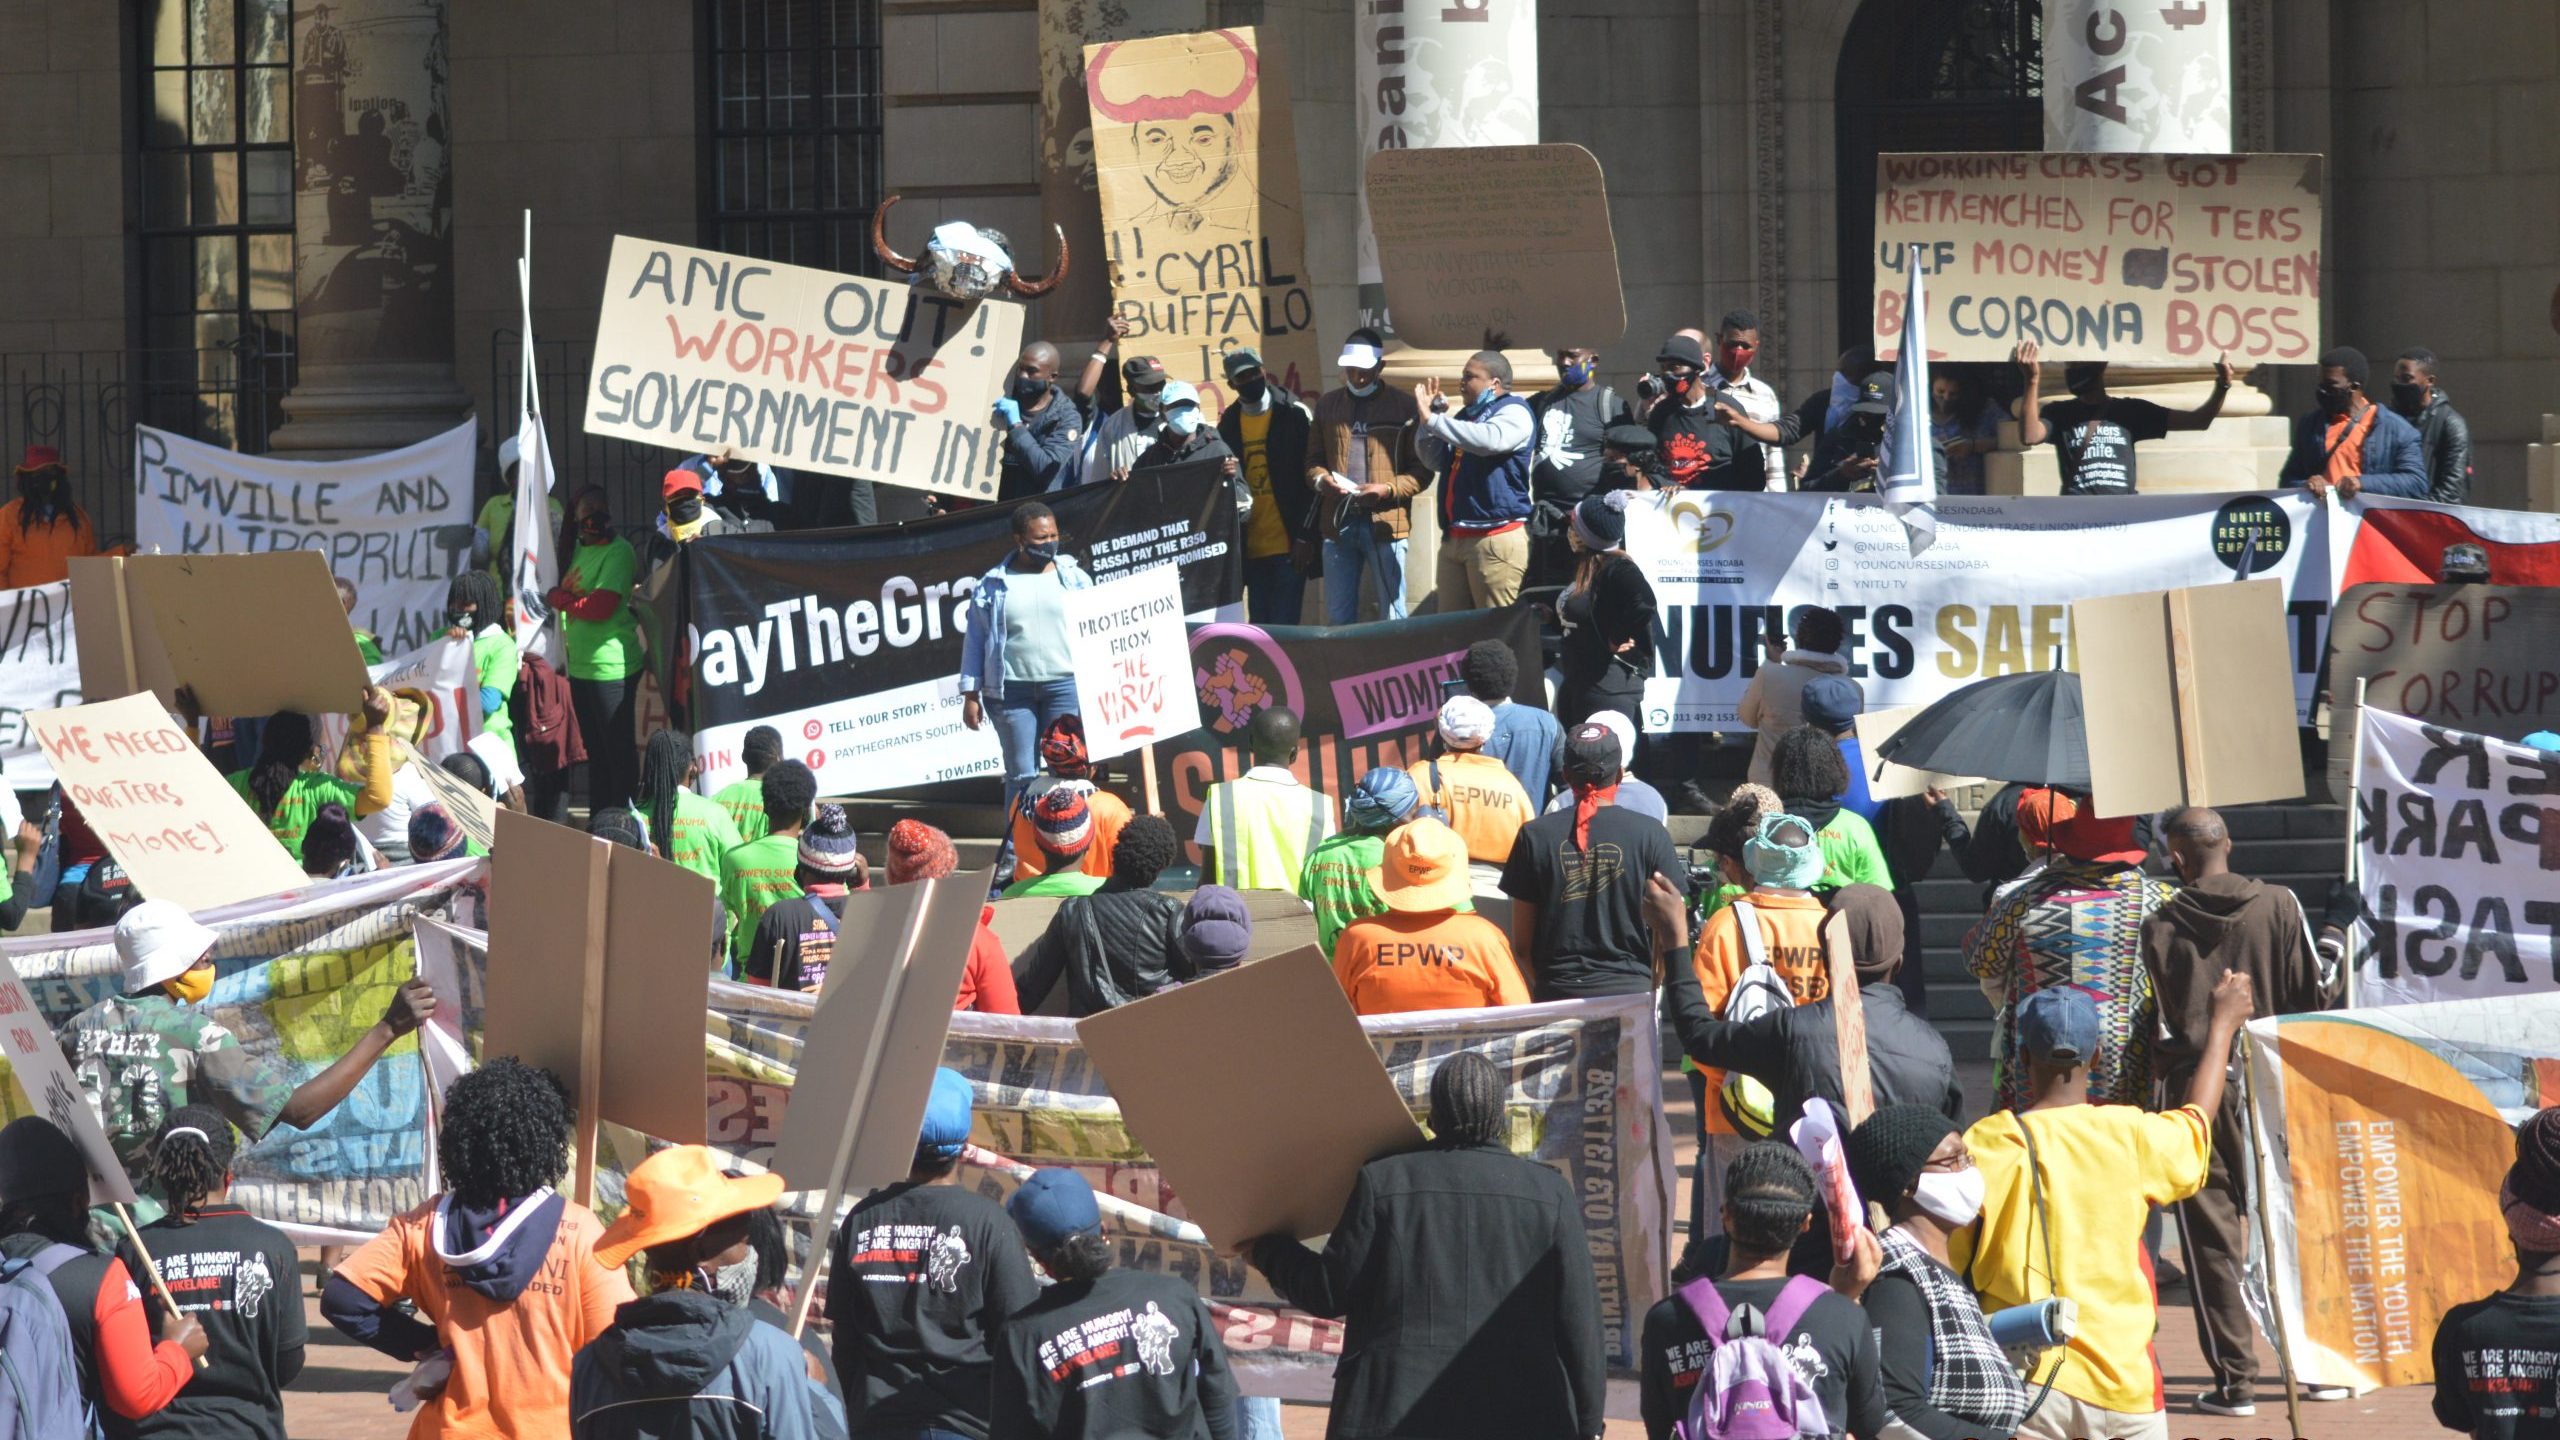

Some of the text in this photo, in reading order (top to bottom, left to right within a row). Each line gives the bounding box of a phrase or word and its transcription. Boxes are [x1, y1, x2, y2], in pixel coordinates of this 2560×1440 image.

[1885, 155, 2247, 188] WORKING CLASS GOT
[1884, 188, 2302, 243] RETRENCHED FOR TERS
[1155, 236, 1296, 296] CYRIL
[1972, 240, 2109, 286] MONEY
[2171, 250, 2320, 298] STOLEN
[629, 251, 772, 321] ANC
[1117, 287, 1312, 339] BUFFALO
[1948, 295, 2144, 351] CORONA
[2165, 299, 2310, 359] BOSS
[665, 314, 948, 415] WORKERS
[596, 364, 916, 473] GOVERNMENT
[2073, 425, 2121, 439] Wkers
[138, 428, 450, 525] PIMVILLE AND
[2229, 511, 2272, 523] UNITE
[1091, 520, 1190, 556] WE DEMAND THAT
[1093, 531, 1207, 572] SASSA PAY THE R350
[1172, 541, 1228, 567] PROMISED
[2217, 540, 2284, 553] EMPWER
[1078, 594, 1175, 638] PROTECTION
[2357, 591, 2512, 653] STOP
[689, 574, 982, 697] ayTheGra
[1110, 629, 1152, 656] FROM
[1649, 603, 1915, 680] NURES
[1113, 652, 1151, 685] THE
[1098, 675, 1168, 726] VIRUS
[1694, 712, 1713, 722] 492
[828, 720, 857, 736] TELL
[859, 711, 890, 729] YOUR
[893, 702, 928, 721] STORY
[39, 723, 188, 764] WE NEED
[835, 731, 923, 761] PAYTHEGRANTS
[937, 757, 1000, 782] TOWARDS
[1452, 785, 1514, 811] EPWP
[1376, 942, 1466, 968] EPWP
[857, 1225, 937, 1243] WE ARE HUNGRY!
[870, 1238, 890, 1250] ARE
[893, 1238, 929, 1250] ANGRY!
[2336, 1120, 2381, 1365] EMPOWER THE NATION
[2369, 1120, 2412, 1364] EMPOWER THE YOUTH,
[166, 1254, 188, 1269] ARE
[191, 1251, 241, 1265] HUNGRY!
[167, 1263, 234, 1280] ARE ANGRY!
[1039, 1308, 1134, 1358] WE ARE HUNGRY!
[1042, 1323, 1130, 1371] WE ARE ANGRY!
[1665, 1339, 1710, 1361] WE ARE
[1668, 1359, 1686, 1375] WE
[2462, 1350, 2477, 1364] WE
[2481, 1348, 2504, 1363] ARE
[2464, 1363, 2554, 1380] WE ARE ANGRY!
